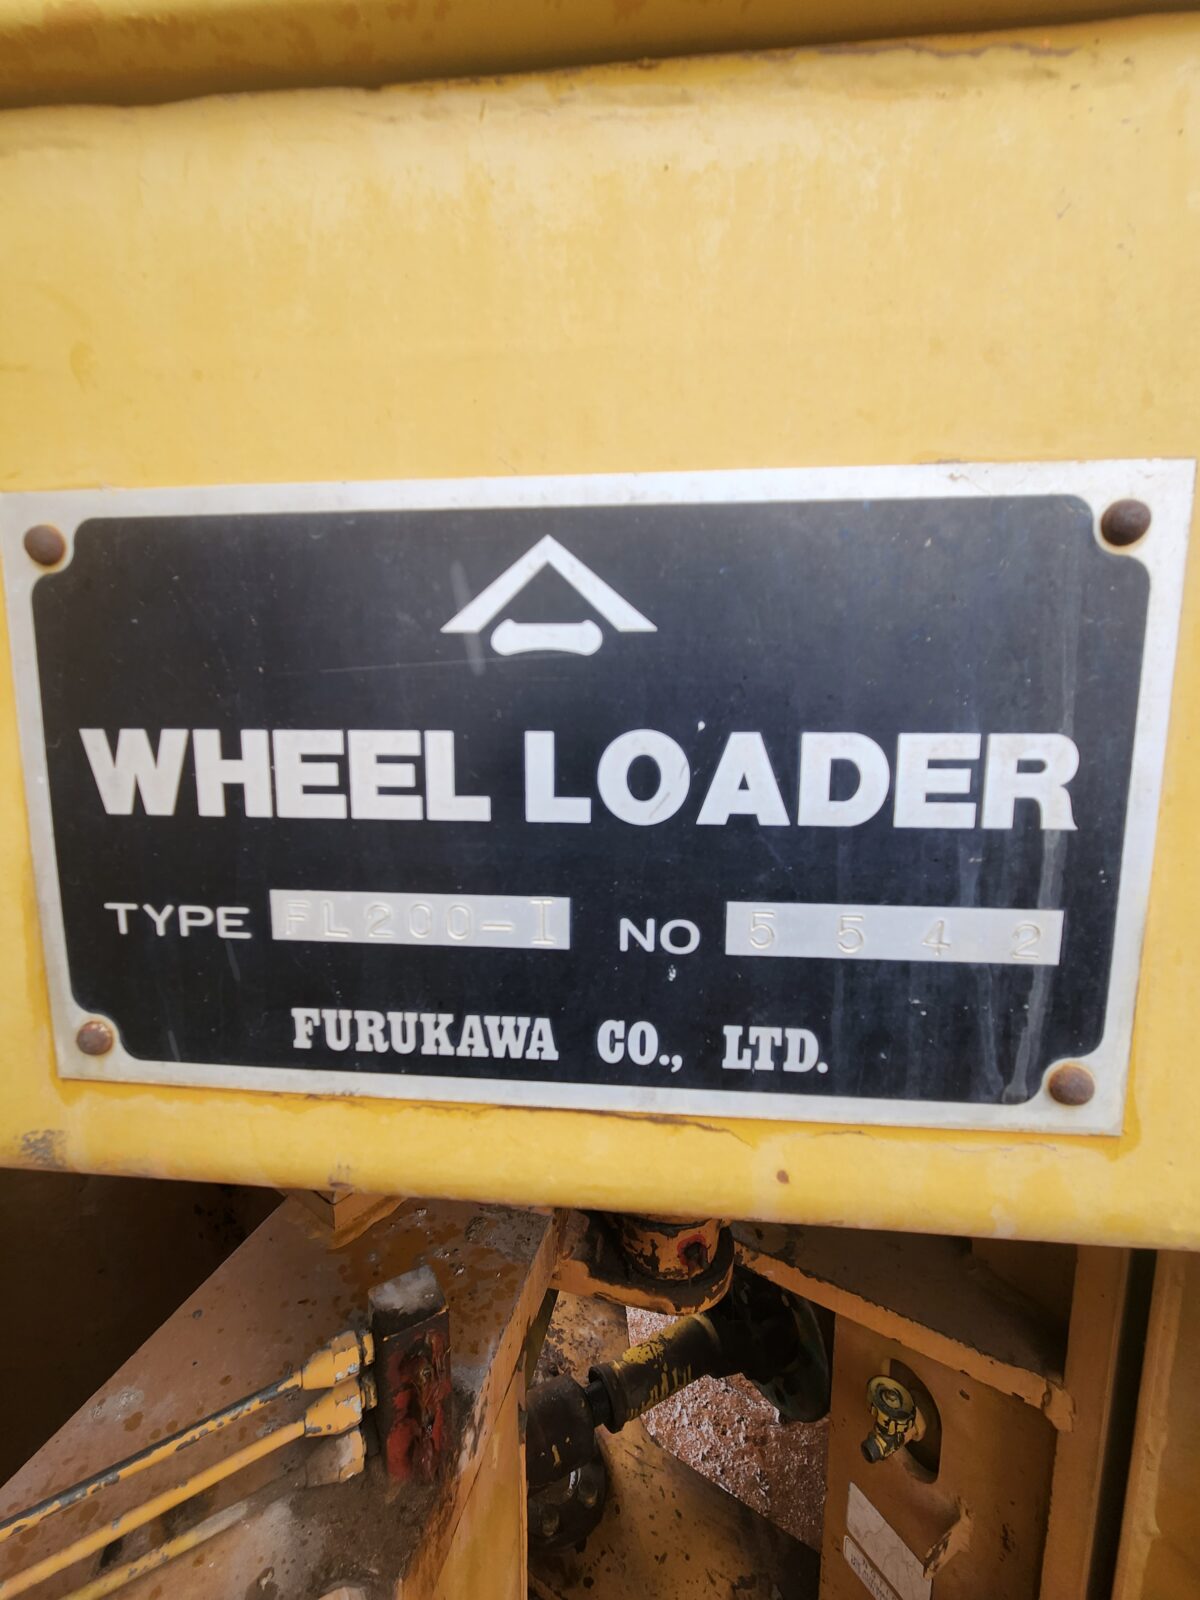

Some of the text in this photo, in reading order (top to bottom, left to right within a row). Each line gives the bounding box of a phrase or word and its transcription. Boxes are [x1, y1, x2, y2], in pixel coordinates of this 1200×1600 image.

[79, 729, 1079, 831] WHEEL LOADER
[105, 902, 252, 940] TYPE
[620, 917, 701, 955] NO
[292, 1008, 829, 1074] FURUKAWA CO., LTD.
